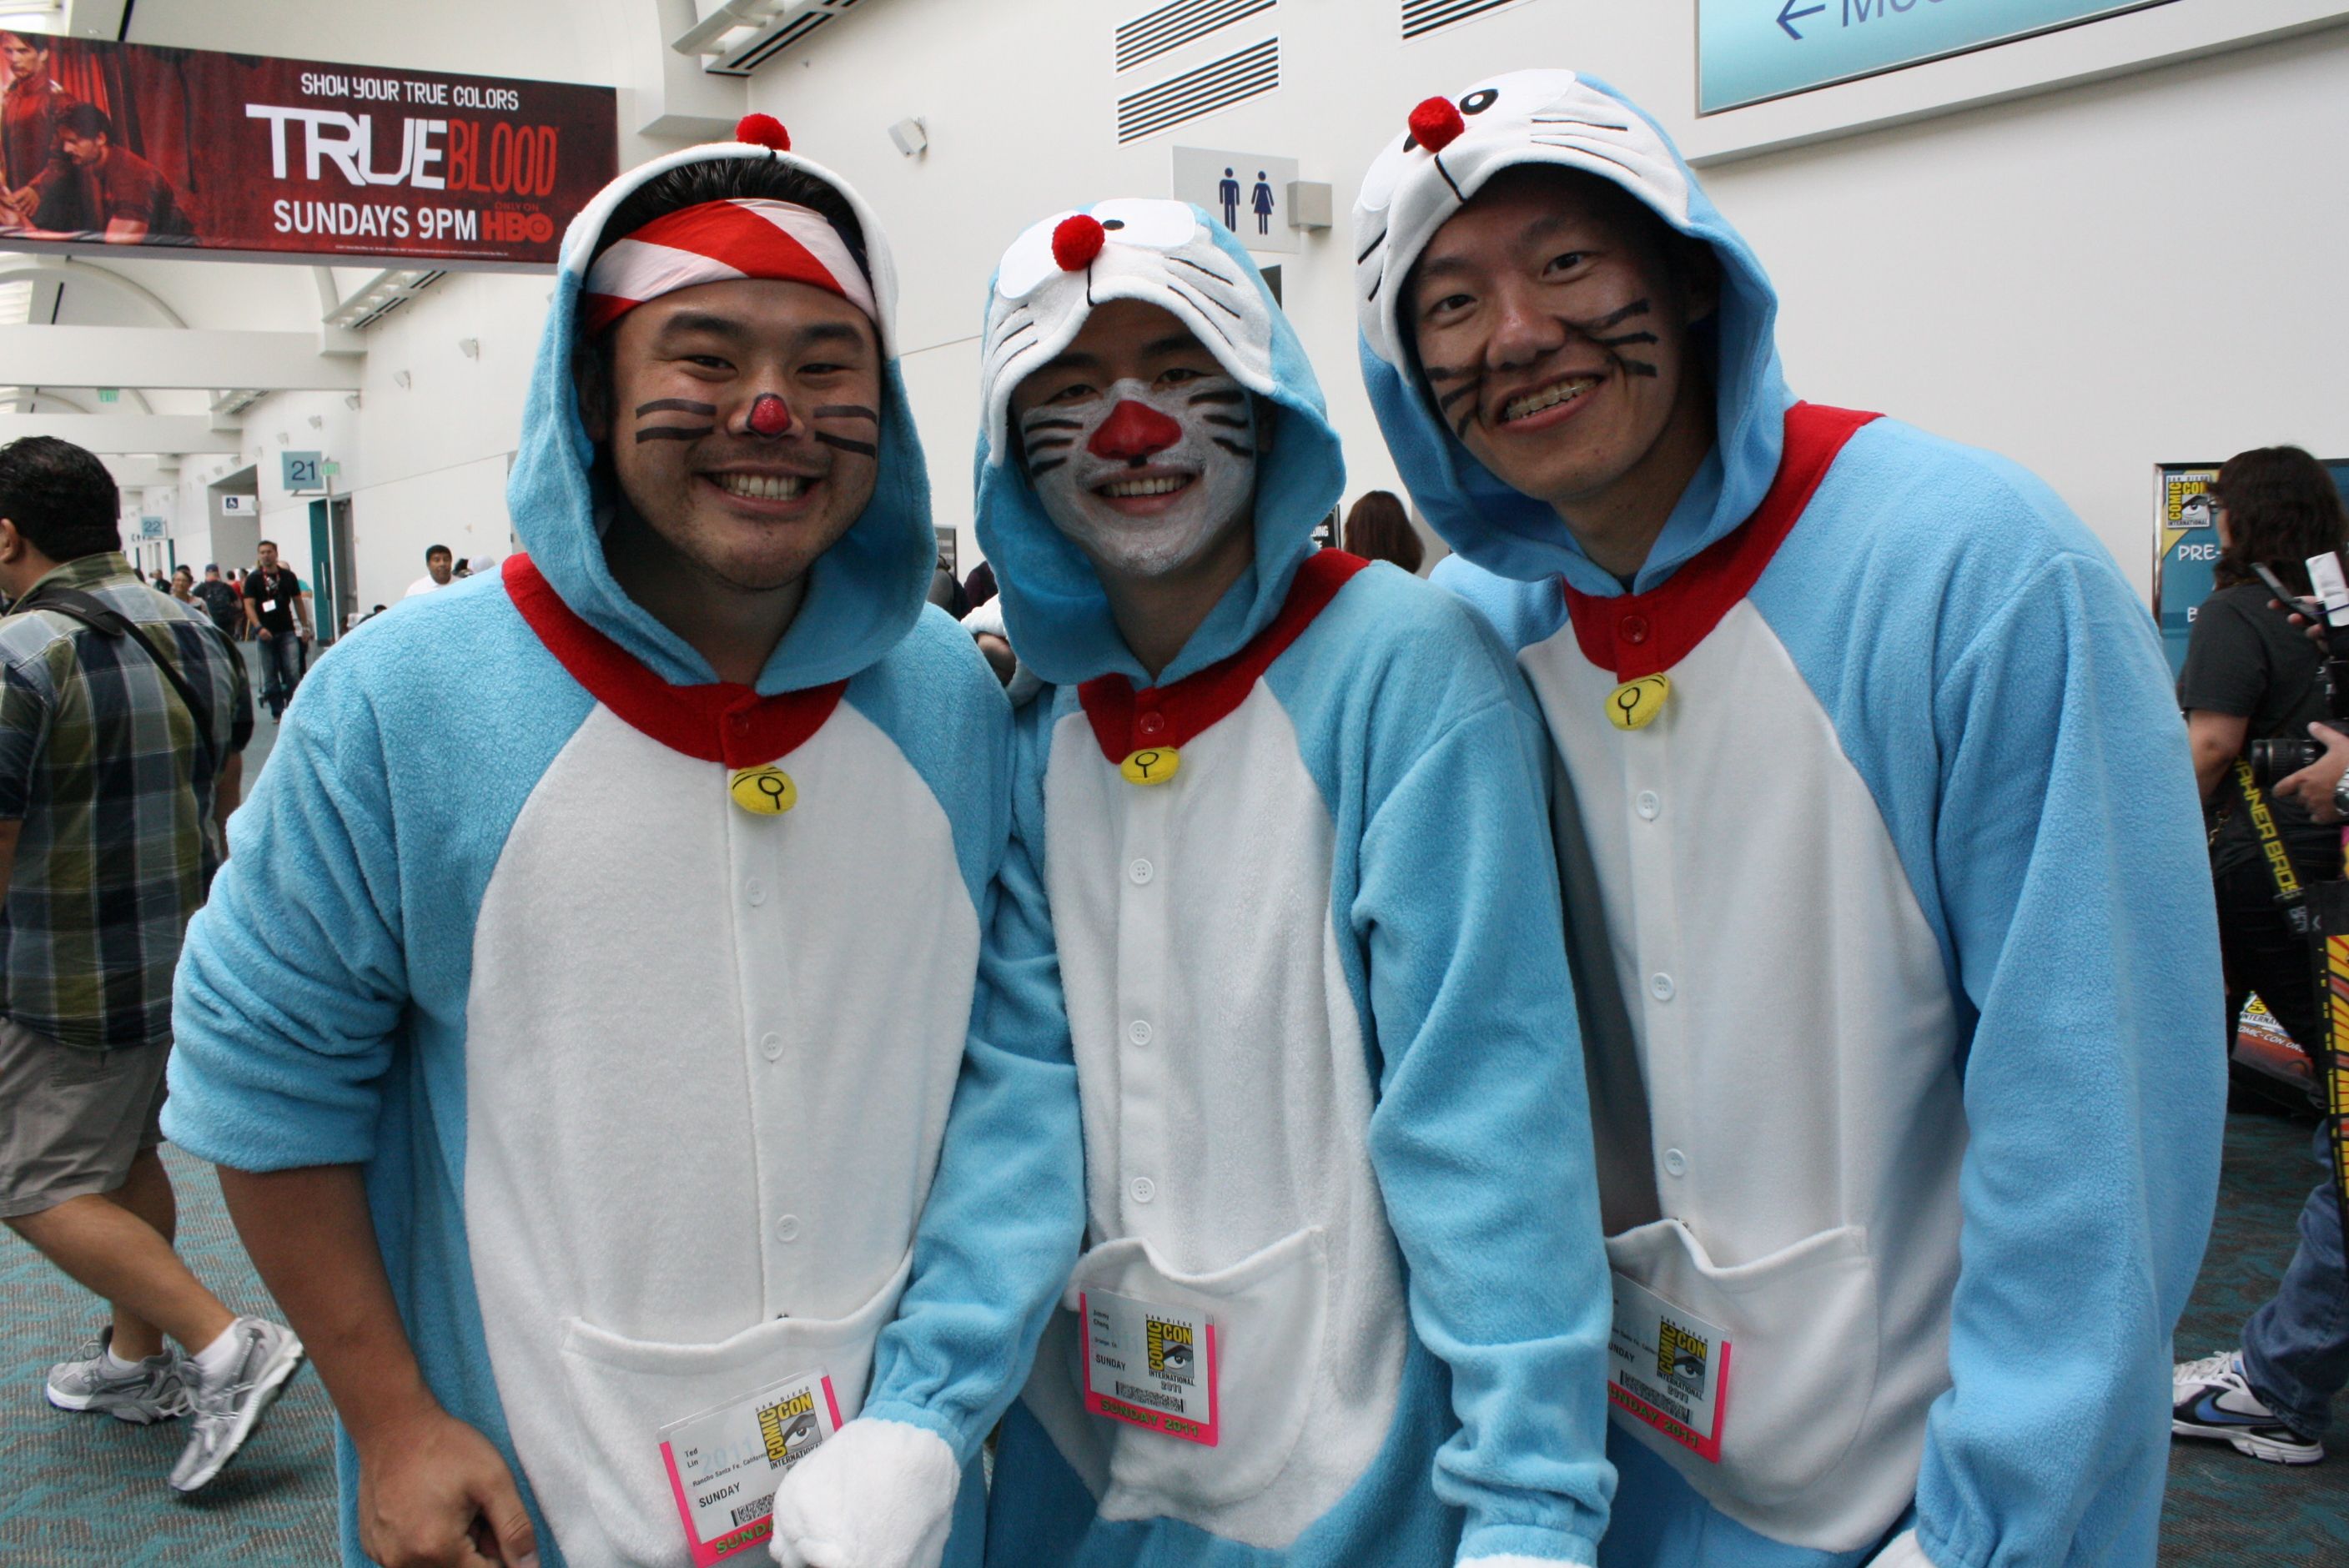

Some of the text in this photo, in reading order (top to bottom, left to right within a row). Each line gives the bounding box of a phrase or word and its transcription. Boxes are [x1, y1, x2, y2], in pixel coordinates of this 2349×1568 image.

[300, 73, 519, 111] SHOW YOUR TRUE COLORS
[245, 103, 558, 198] TRUE BLOOD
[495, 200, 540, 212] ONLY ON
[274, 199, 477, 242] SUNDAYS 9PM
[481, 209, 555, 244] HBO
[291, 460, 315, 481] 21
[2168, 482, 2182, 520] COMIC
[143, 520, 161, 533] 22
[1145, 1313, 1193, 1328] SAN DIEGO
[1147, 1321, 1164, 1372] COMIC
[1162, 1324, 1193, 1346] CON
[1676, 1332, 1707, 1361] CON
[1095, 1354, 1126, 1372] SUNDAY
[1608, 1341, 1635, 1364] UNDAY
[1658, 1324, 1676, 1375] COMIC
[1149, 1369, 1195, 1387] INTERNATIONAL
[1160, 1380, 1182, 1394] 2011
[1657, 1369, 1704, 1402] INTERNATIONAL
[755, 1385, 810, 1412] SAN DIEGO
[777, 1391, 813, 1421] CON
[1100, 1398, 1199, 1437] SUNDAY 2011
[1608, 1381, 1699, 1448] UNDAY 2011
[758, 1408, 787, 1460] COMIC
[685, 1447, 699, 1458] Ted
[687, 1459, 699, 1469] Lin
[715, 1467, 732, 1478] Santa
[699, 1481, 741, 1508] SUNDAY
